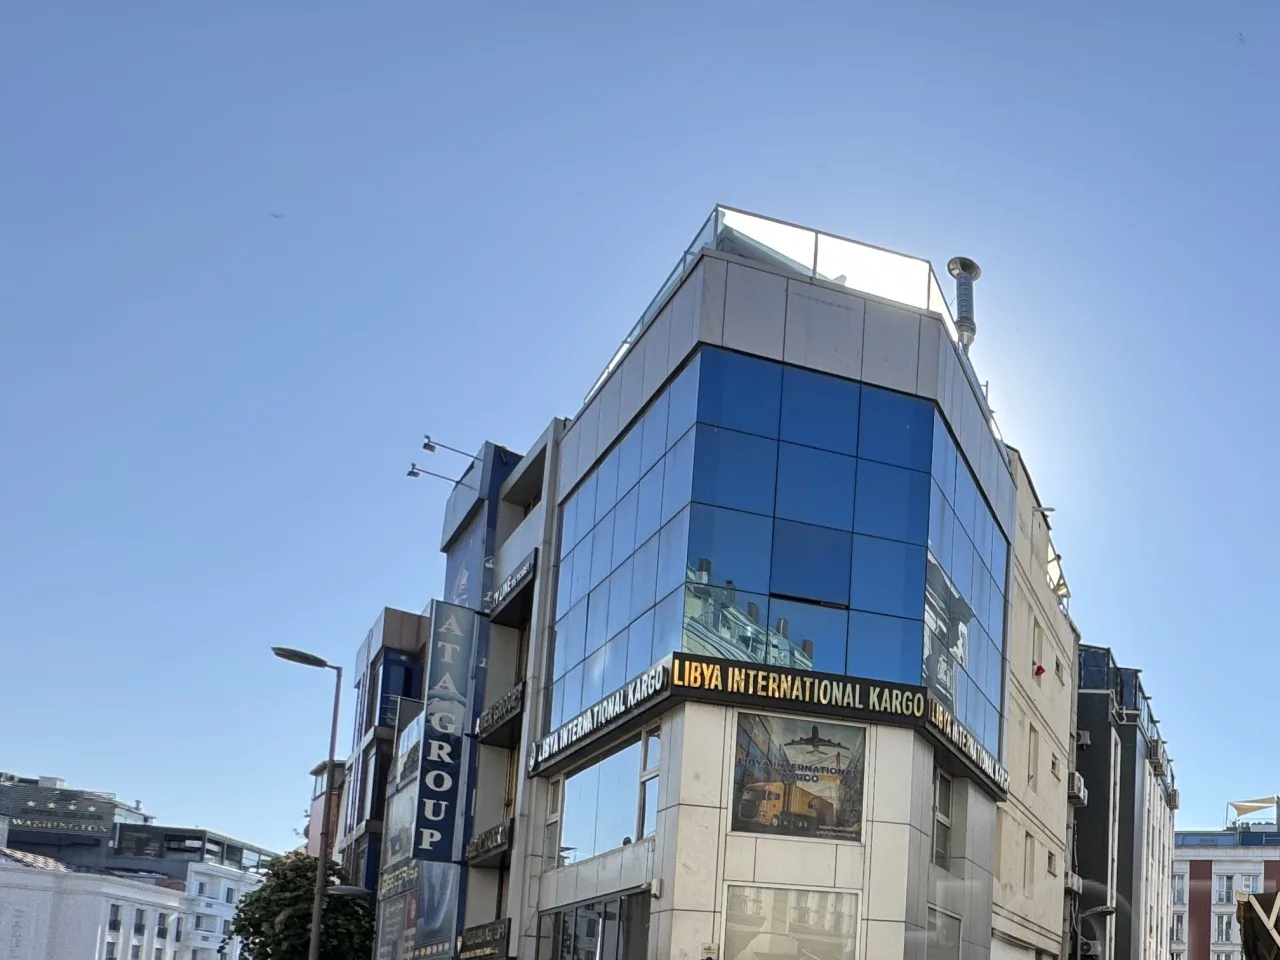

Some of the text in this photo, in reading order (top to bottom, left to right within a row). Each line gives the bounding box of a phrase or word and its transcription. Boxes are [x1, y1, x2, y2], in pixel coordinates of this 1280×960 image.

[538, 665, 663, 762] LIBYA INTERNATIONAL KARGO
[673, 658, 924, 717] LIBYA INTERNATIONAL KARGO
[418, 613, 464, 850] ATA GROUP
[931, 702, 951, 738] LIBYA
[952, 722, 994, 780] INTERNATIONAL
[738, 758, 858, 777] LIBYA INTERNATIONAL
[780, 771, 819, 783] KARGO
[12, 818, 108, 833] WASHINGTON
